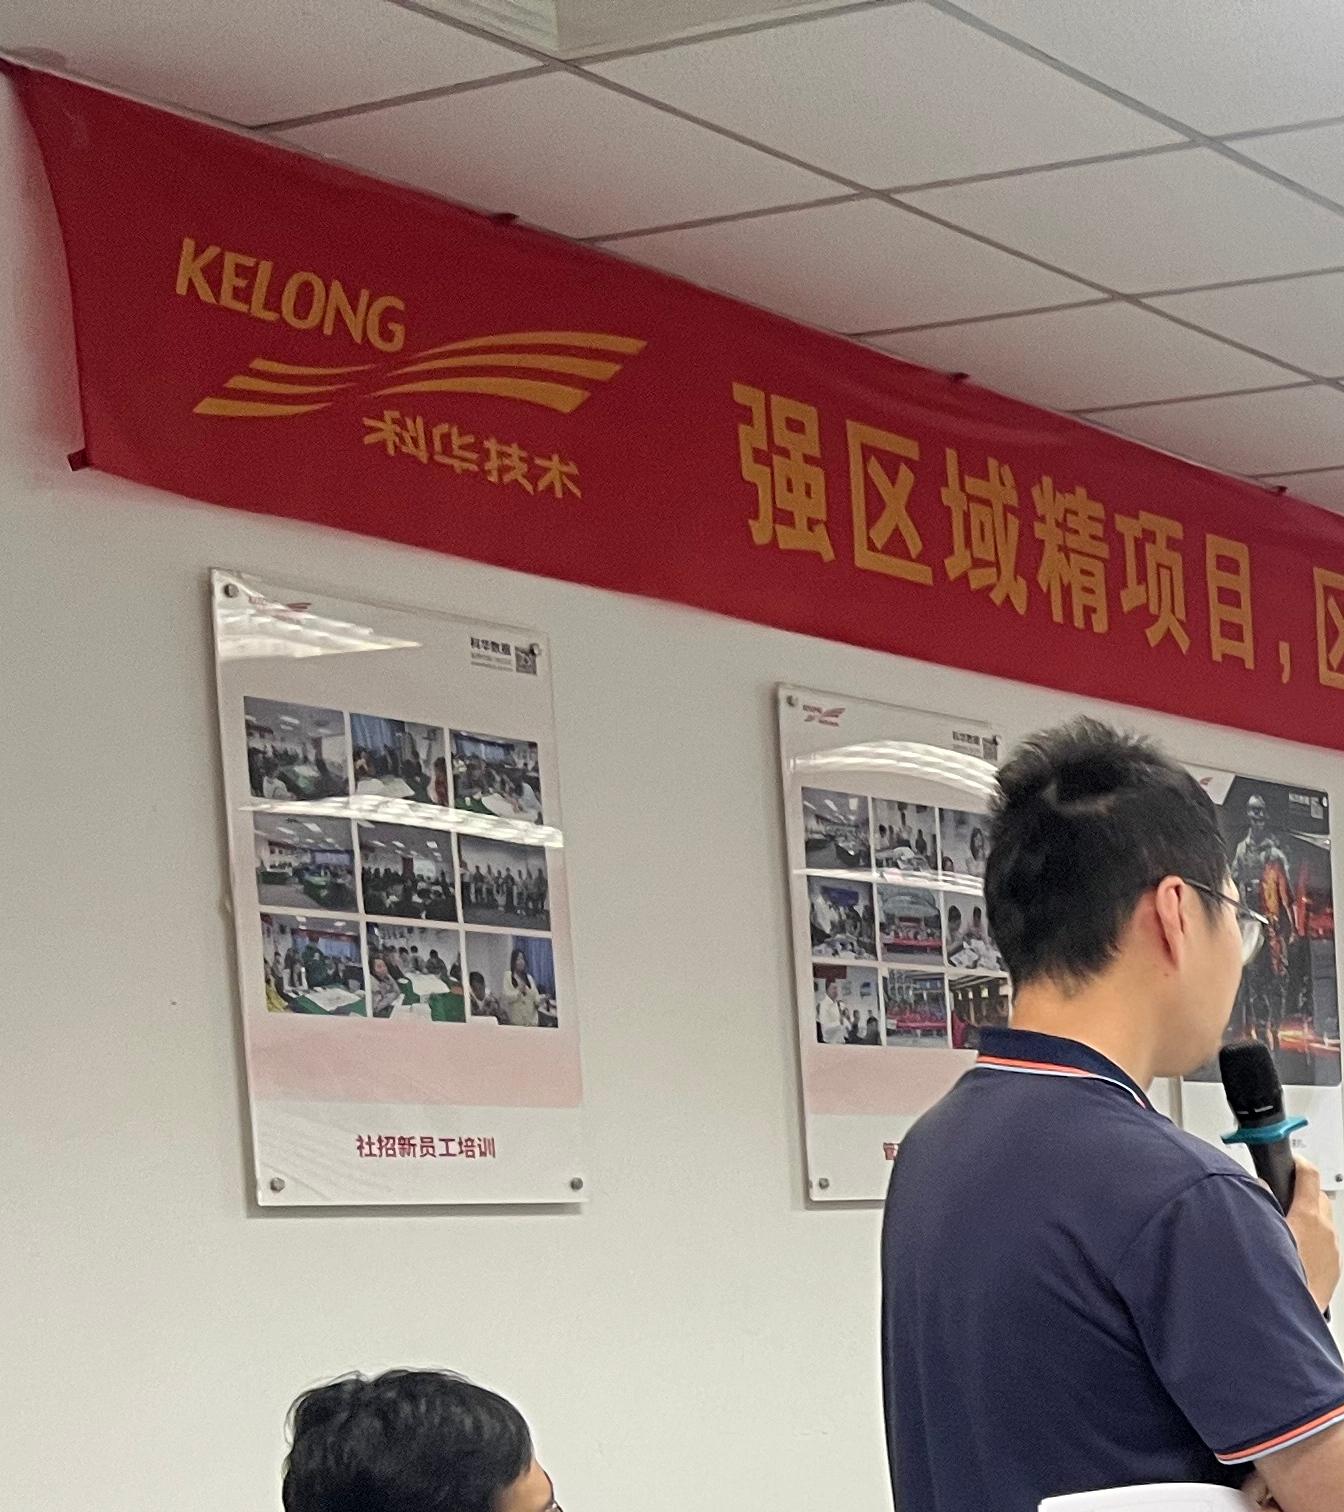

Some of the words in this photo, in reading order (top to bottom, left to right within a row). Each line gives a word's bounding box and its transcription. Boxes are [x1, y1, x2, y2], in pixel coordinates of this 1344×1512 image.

[176, 237, 406, 353] KELONG
[362, 409, 582, 499] 科华技术
[356, 1135, 497, 1159] 社招新员工培训
